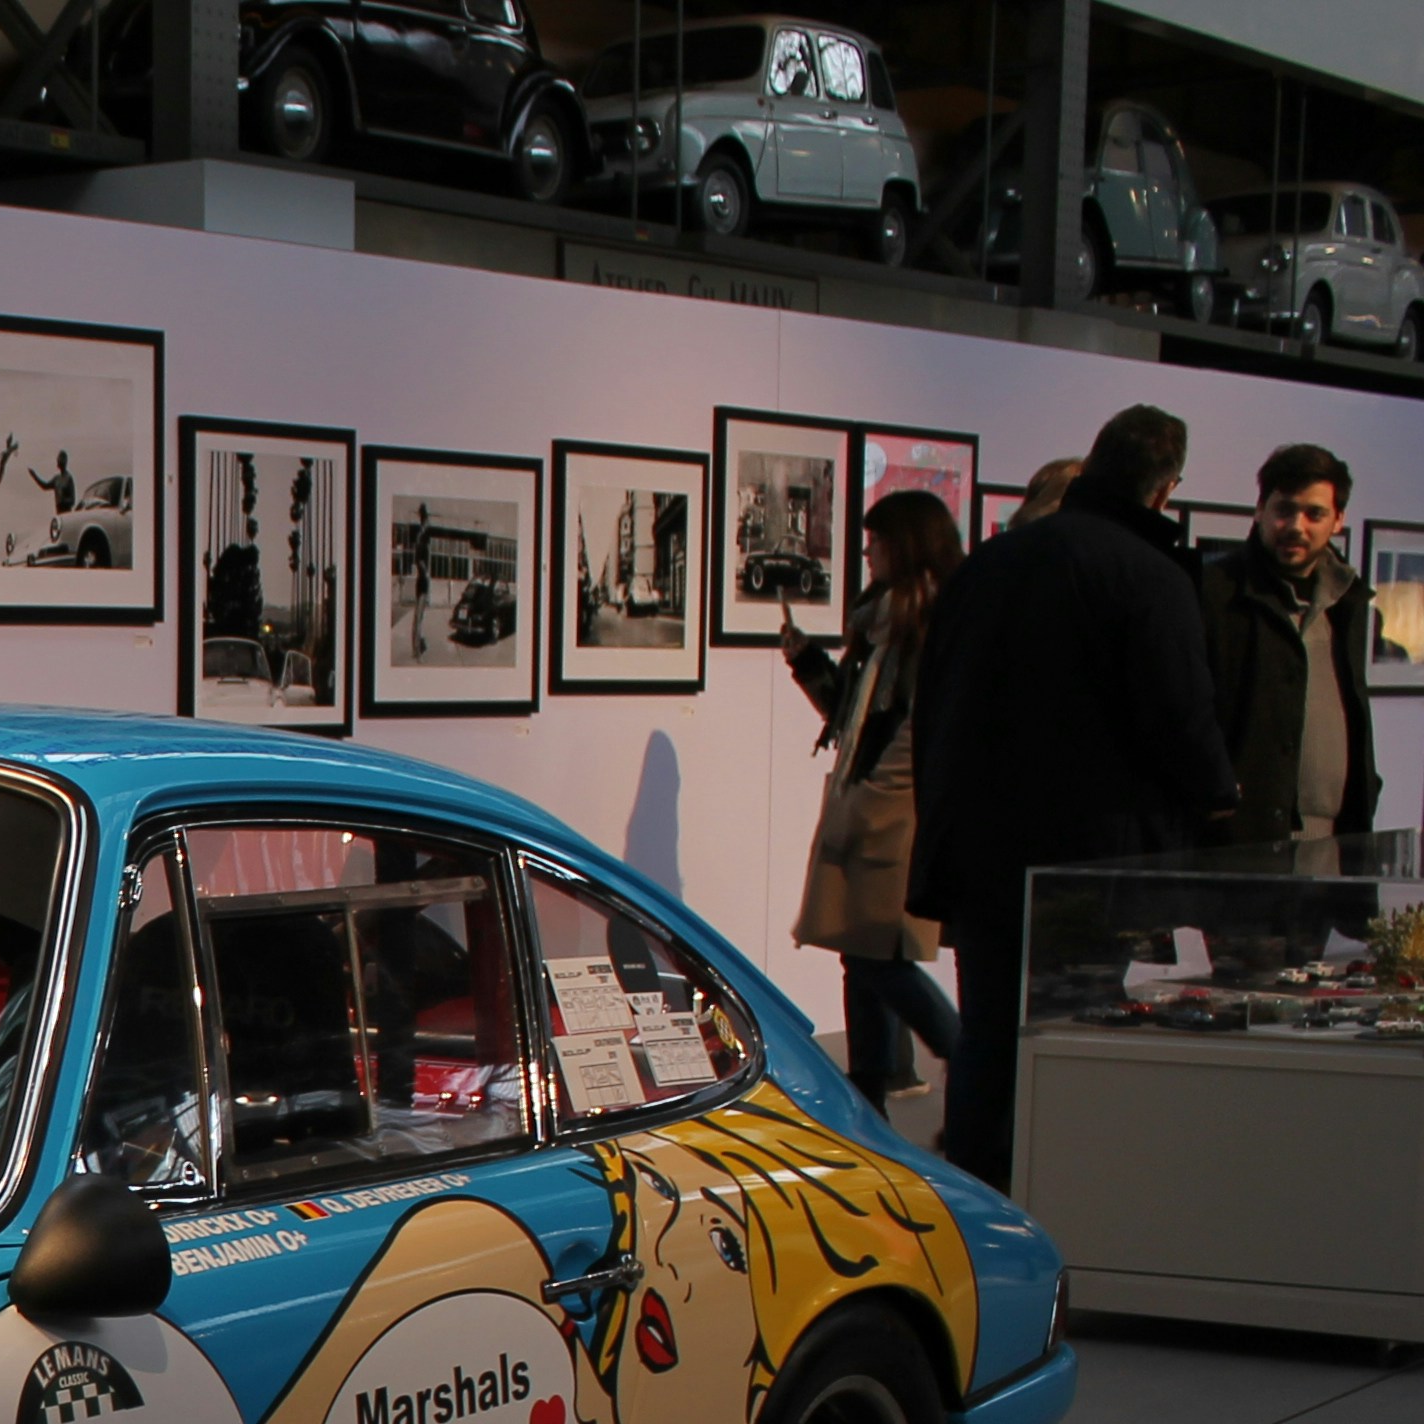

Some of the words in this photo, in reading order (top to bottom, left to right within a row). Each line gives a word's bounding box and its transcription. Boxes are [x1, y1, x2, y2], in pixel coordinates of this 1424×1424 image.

[171, 1234, 283, 1277] BENJAMIN
[34, 1354, 56, 1388] LE
[53, 1345, 111, 1377] MANS
[58, 1371, 90, 1389] CLASSIC
